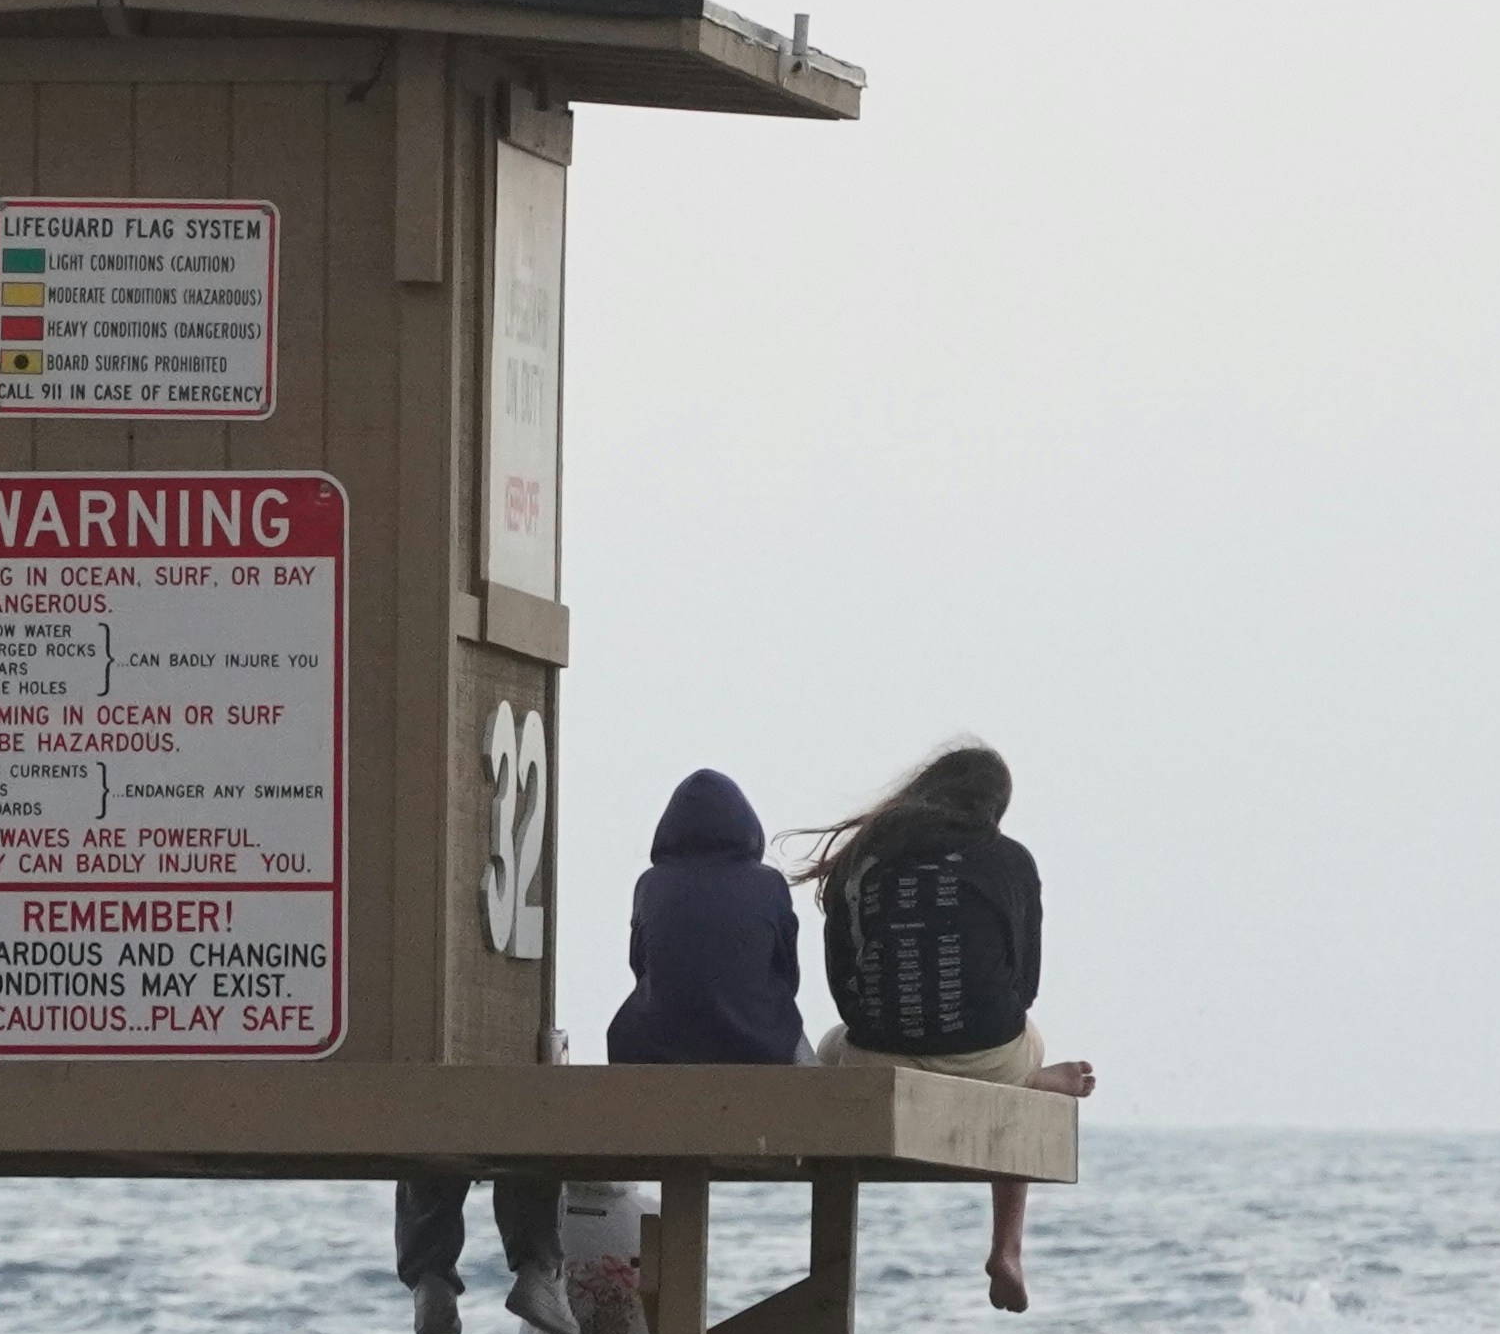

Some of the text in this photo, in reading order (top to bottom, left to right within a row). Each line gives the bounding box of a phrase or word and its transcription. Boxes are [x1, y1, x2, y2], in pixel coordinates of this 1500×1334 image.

[4, 217, 261, 240] LIFEGUARD FLAG SYSTEM
[49, 254, 235, 273] LIGHT CONDITIONS (CAUTION)
[48, 287, 262, 306] MODERATE CONDITIONS (HAZARDOUS)
[48, 321, 261, 340] HEAVY CONDITIONS (DANGEROUS)
[47, 355, 226, 373] BOARD SURFING PROHIBITED
[42, 384, 62, 400] 911
[70, 385, 85, 400] IN
[94, 385, 132, 400] CASE
[141, 385, 160, 401] OF
[168, 386, 262, 403] EMERGENCY
[27, 567, 46, 586] IN
[61, 567, 141, 588] OCEAN,
[155, 567, 218, 588] SURF,
[232, 567, 259, 585] OR
[275, 566, 316, 585] BAY
[24, 624, 71, 637] WATER
[46, 643, 96, 657] ROCKS
[170, 654, 214, 667] BADLY
[226, 654, 279, 667] INJURE
[289, 654, 318, 667] YOU
[19, 681, 66, 694] HOLES
[63, 706, 83, 725] IN
[98, 706, 171, 725] OCEAN
[185, 706, 213, 725] OR
[228, 706, 284, 725] SURF
[38, 733, 181, 752] HAZARDOUS.
[10, 764, 88, 778] CURRENTS
[214, 784, 244, 798] ANY
[254, 784, 323, 798] SWIMMER
[0, 828, 260, 847] WAVES ARE POWERFUL.
[486, 699, 547, 960] 32
[19, 854, 62, 873] CAN
[76, 854, 145, 873] BADLY
[159, 854, 236, 873] INJURE
[262, 854, 311, 873] YOU.
[23, 901, 233, 933] REMEMBER!
[118, 943, 173, 967] AND
[190, 943, 327, 967] CHANGING
[142, 973, 196, 997] MAY
[214, 973, 292, 997] EXIST.
[243, 1006, 314, 1031] SAFE
